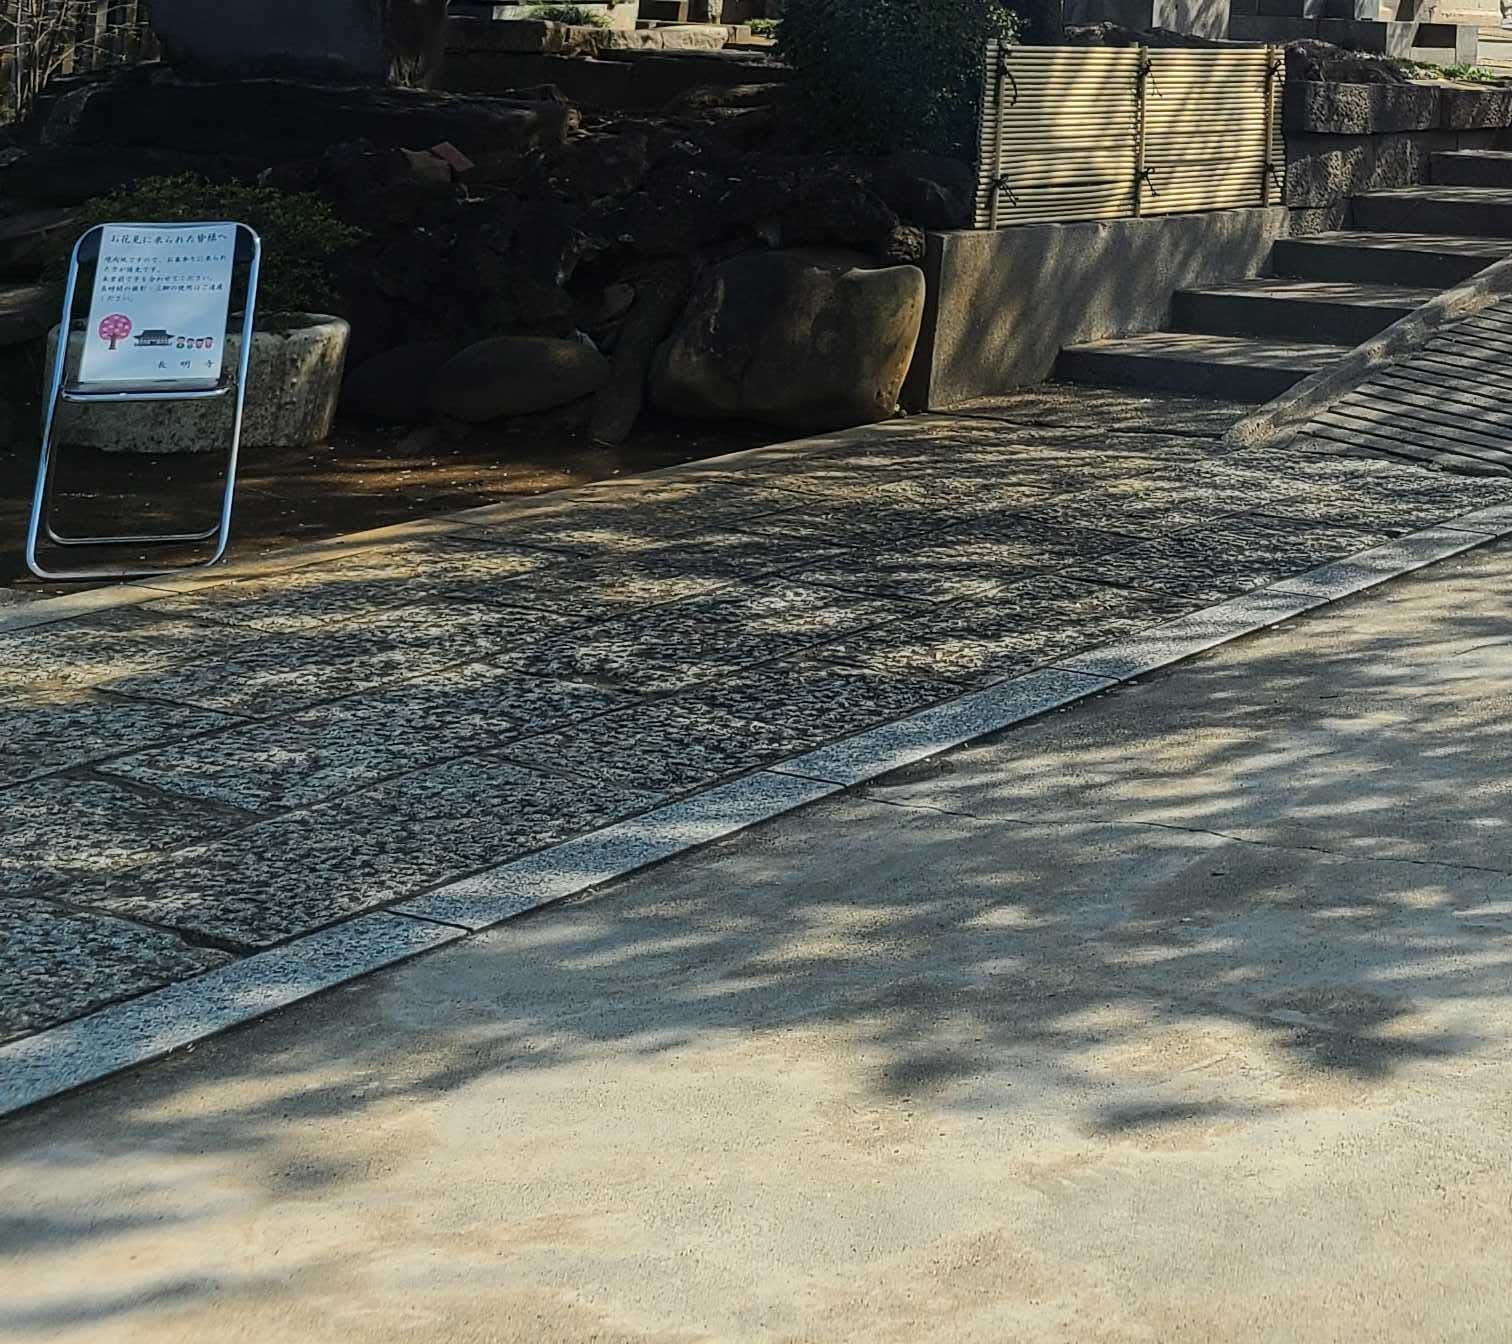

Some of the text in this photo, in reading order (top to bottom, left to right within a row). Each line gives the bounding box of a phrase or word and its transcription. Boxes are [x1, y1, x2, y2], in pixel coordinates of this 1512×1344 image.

[111, 232, 228, 244] お花見に来られた皆様へ
